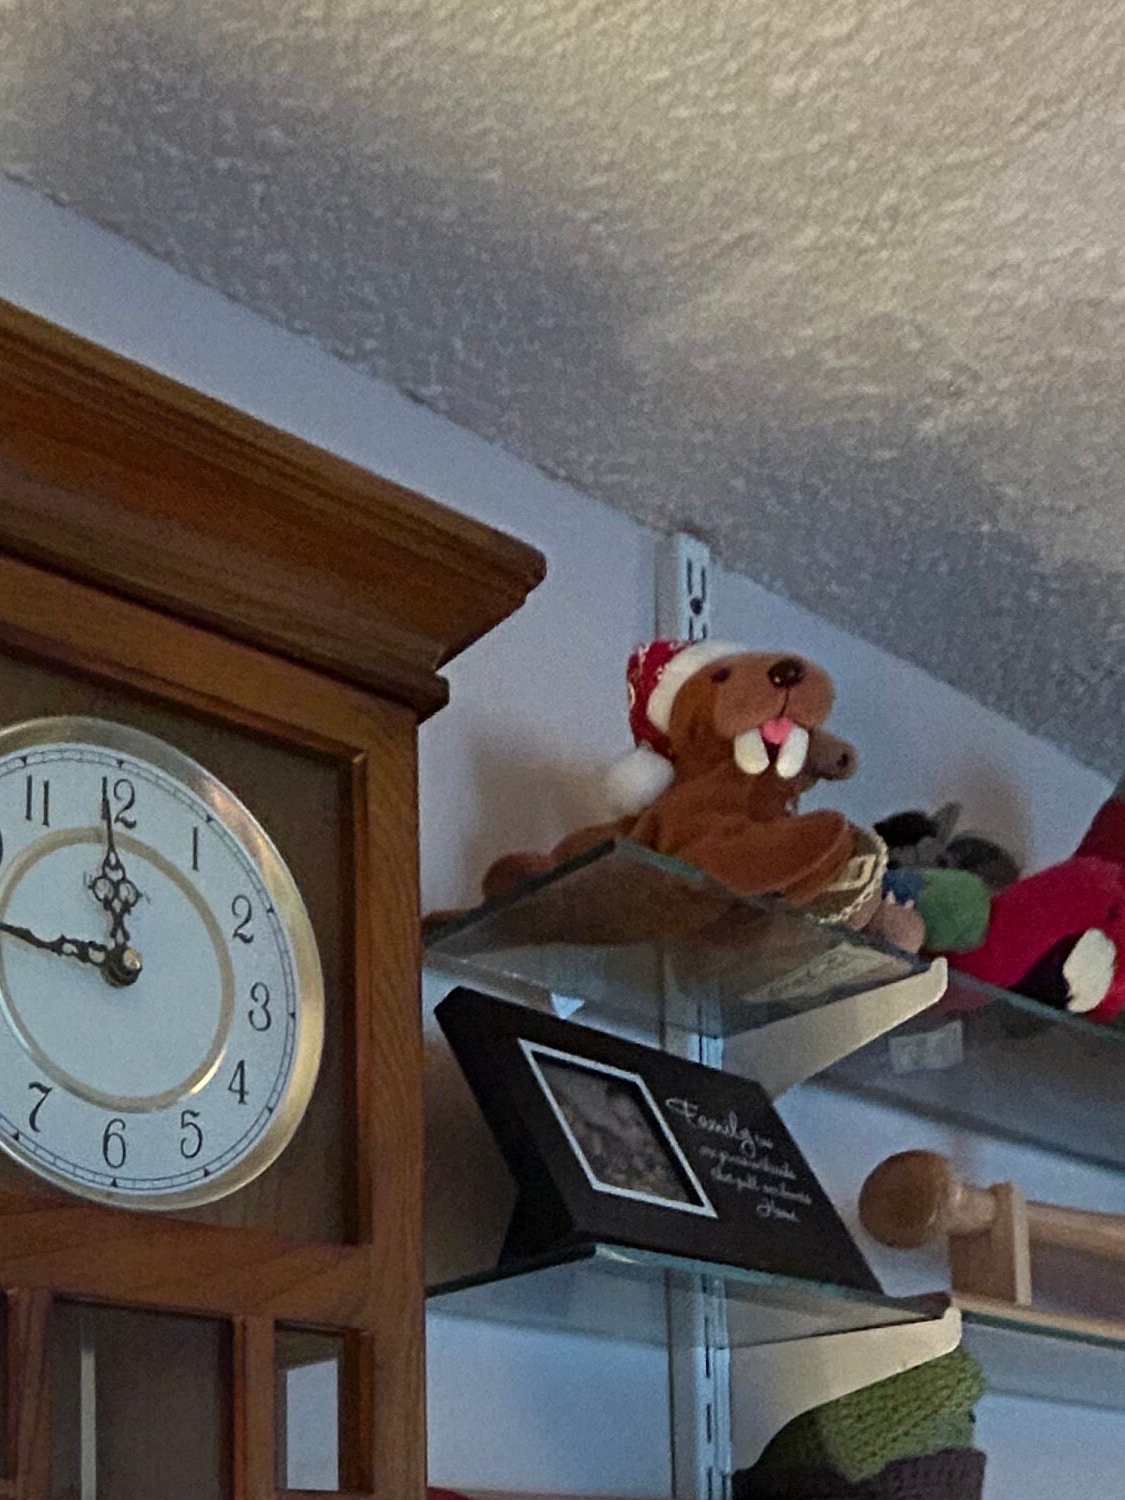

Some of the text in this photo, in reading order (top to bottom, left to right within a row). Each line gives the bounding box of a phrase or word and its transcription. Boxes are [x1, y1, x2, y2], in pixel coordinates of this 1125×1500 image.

[25, 775, 50, 826] 11
[101, 776, 137, 829] 12
[191, 826, 200, 871] 1
[232, 895, 254, 943] 2
[248, 981, 272, 1032] 3
[28, 1081, 53, 1133] 7
[228, 1059, 249, 1105] 4
[102, 1118, 127, 1169] 6
[180, 1109, 203, 1158] 5
[665, 1097, 756, 1158] Family
